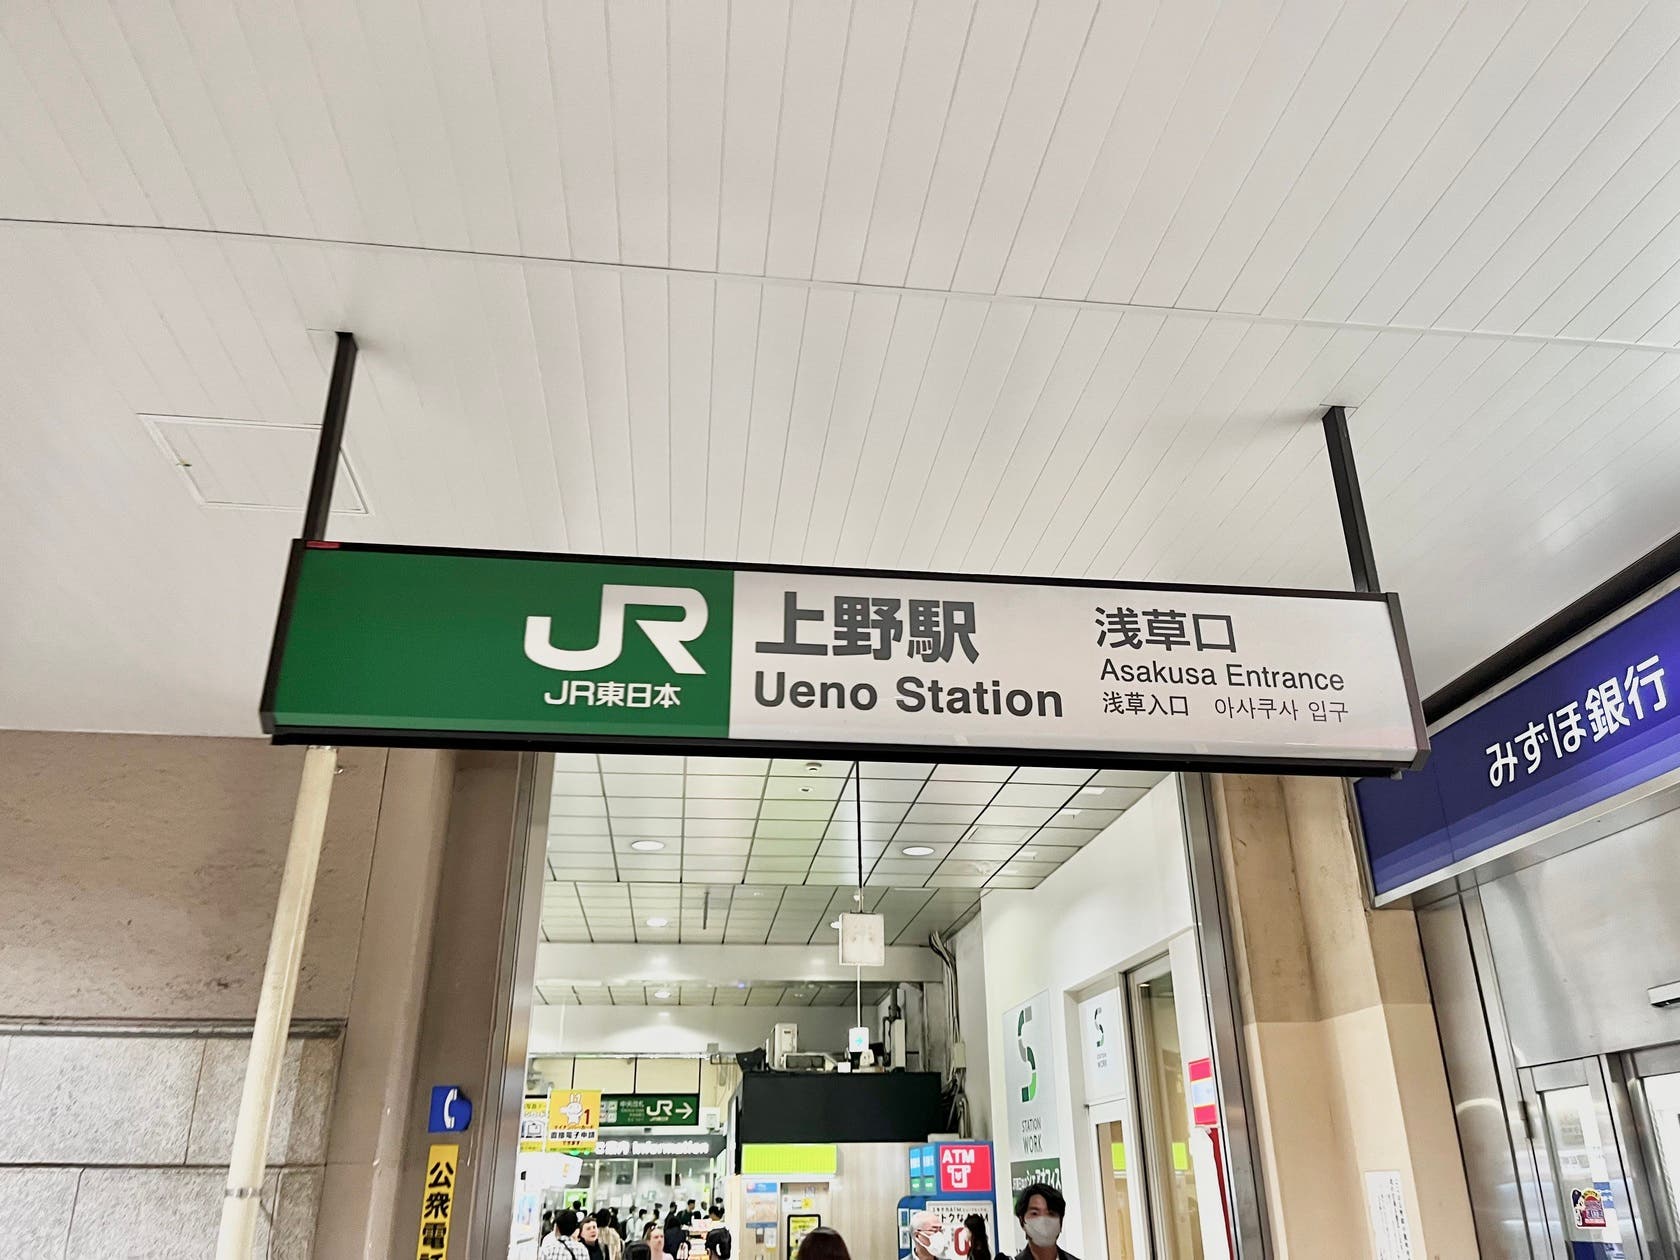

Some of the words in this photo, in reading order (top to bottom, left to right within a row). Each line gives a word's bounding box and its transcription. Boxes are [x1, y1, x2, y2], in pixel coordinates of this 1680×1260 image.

[524, 584, 709, 675] JR
[755, 591, 980, 665] 上野駅
[1095, 606, 1238, 653] 浅草口
[1100, 658, 1218, 687] Asakusa
[1226, 663, 1345, 692] Entrance
[543, 680, 682, 709] JR東日本
[754, 670, 877, 711] Ueno
[895, 675, 1064, 717] Station
[1102, 691, 1189, 717] 浅草入口
[1213, 696, 1299, 722] 아사쿠사
[1307, 700, 1350, 723] 입구
[1485, 655, 1668, 788] みずほ銀行
[646, 1099, 673, 1117] JR
[1021, 1117, 1042, 1132] STATION
[942, 1148, 975, 1164] ATM
[1022, 1134, 1044, 1154] WORK
[419, 1161, 454, 1260] 公衆電
